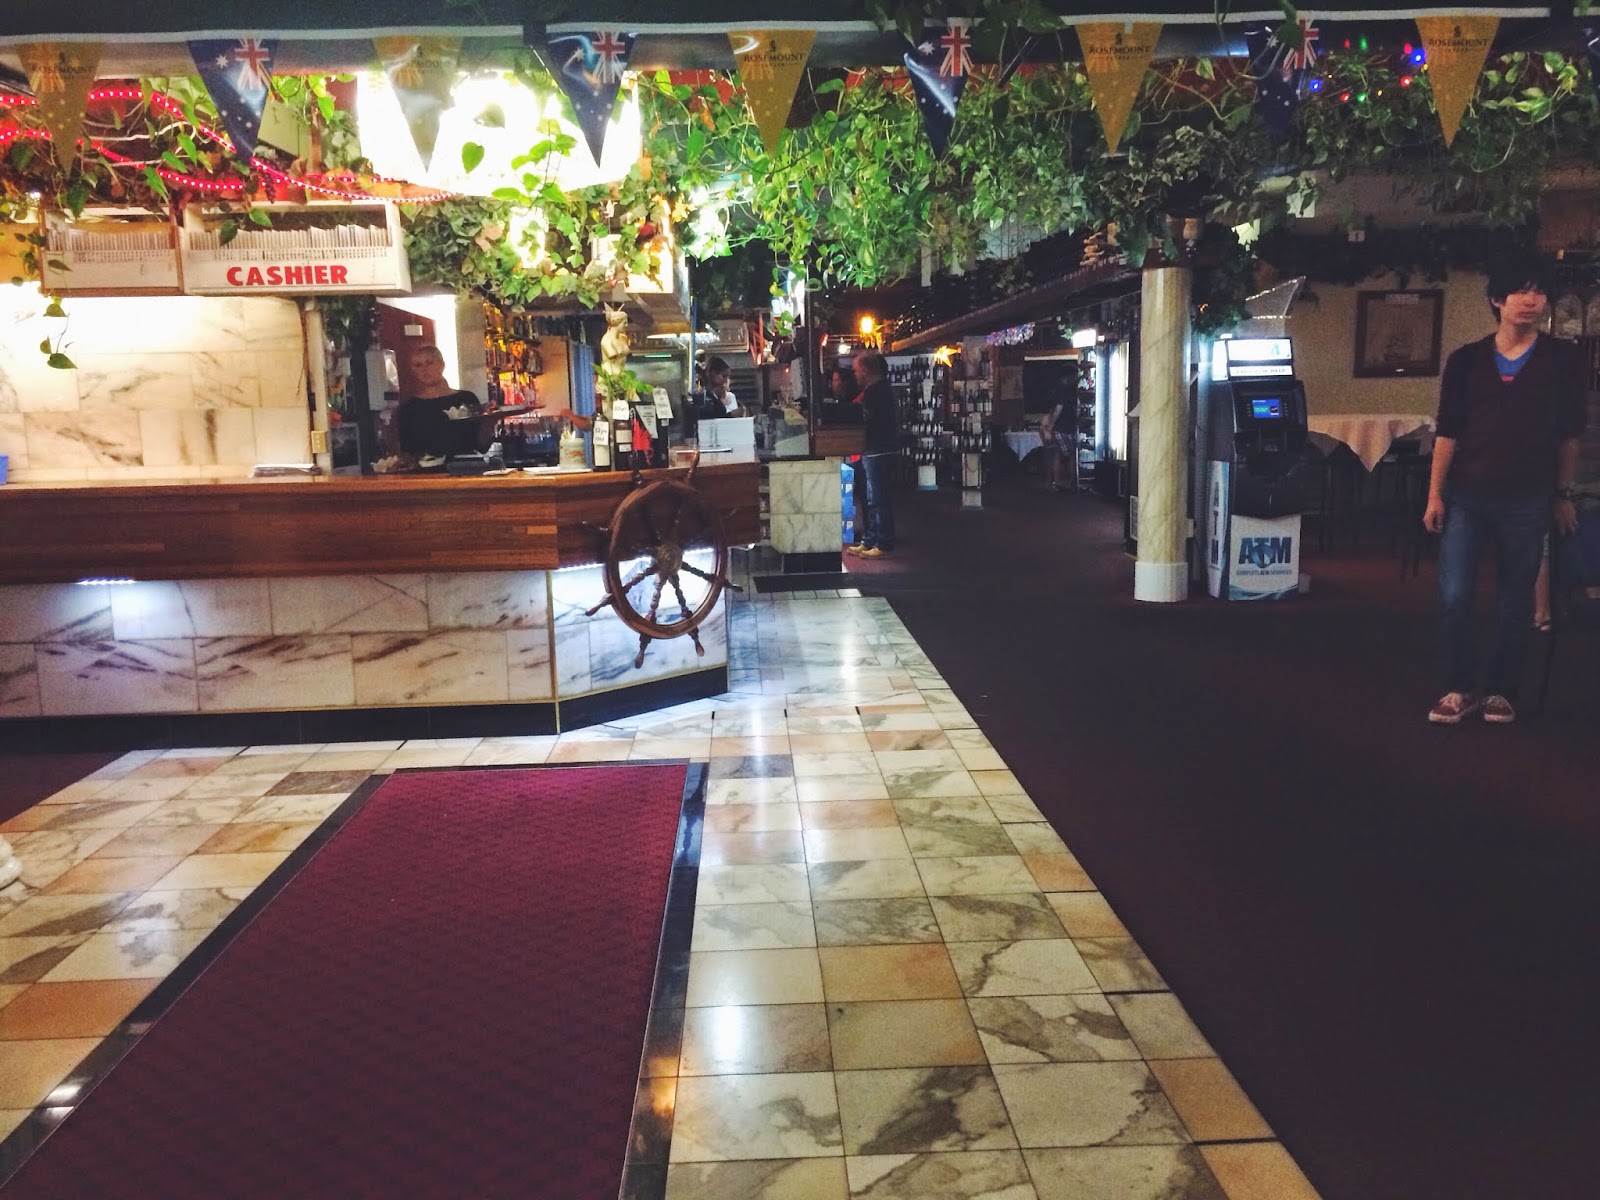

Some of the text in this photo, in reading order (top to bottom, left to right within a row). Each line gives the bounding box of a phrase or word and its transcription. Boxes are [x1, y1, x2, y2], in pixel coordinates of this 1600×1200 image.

[1428, 38, 1488, 47] ROSEMOUNT
[1089, 45, 1150, 55] ROSEMOUNT
[743, 52, 804, 63] ROSEMOUNT
[226, 264, 349, 287] CASHIER
[1238, 537, 1292, 569] ATM
